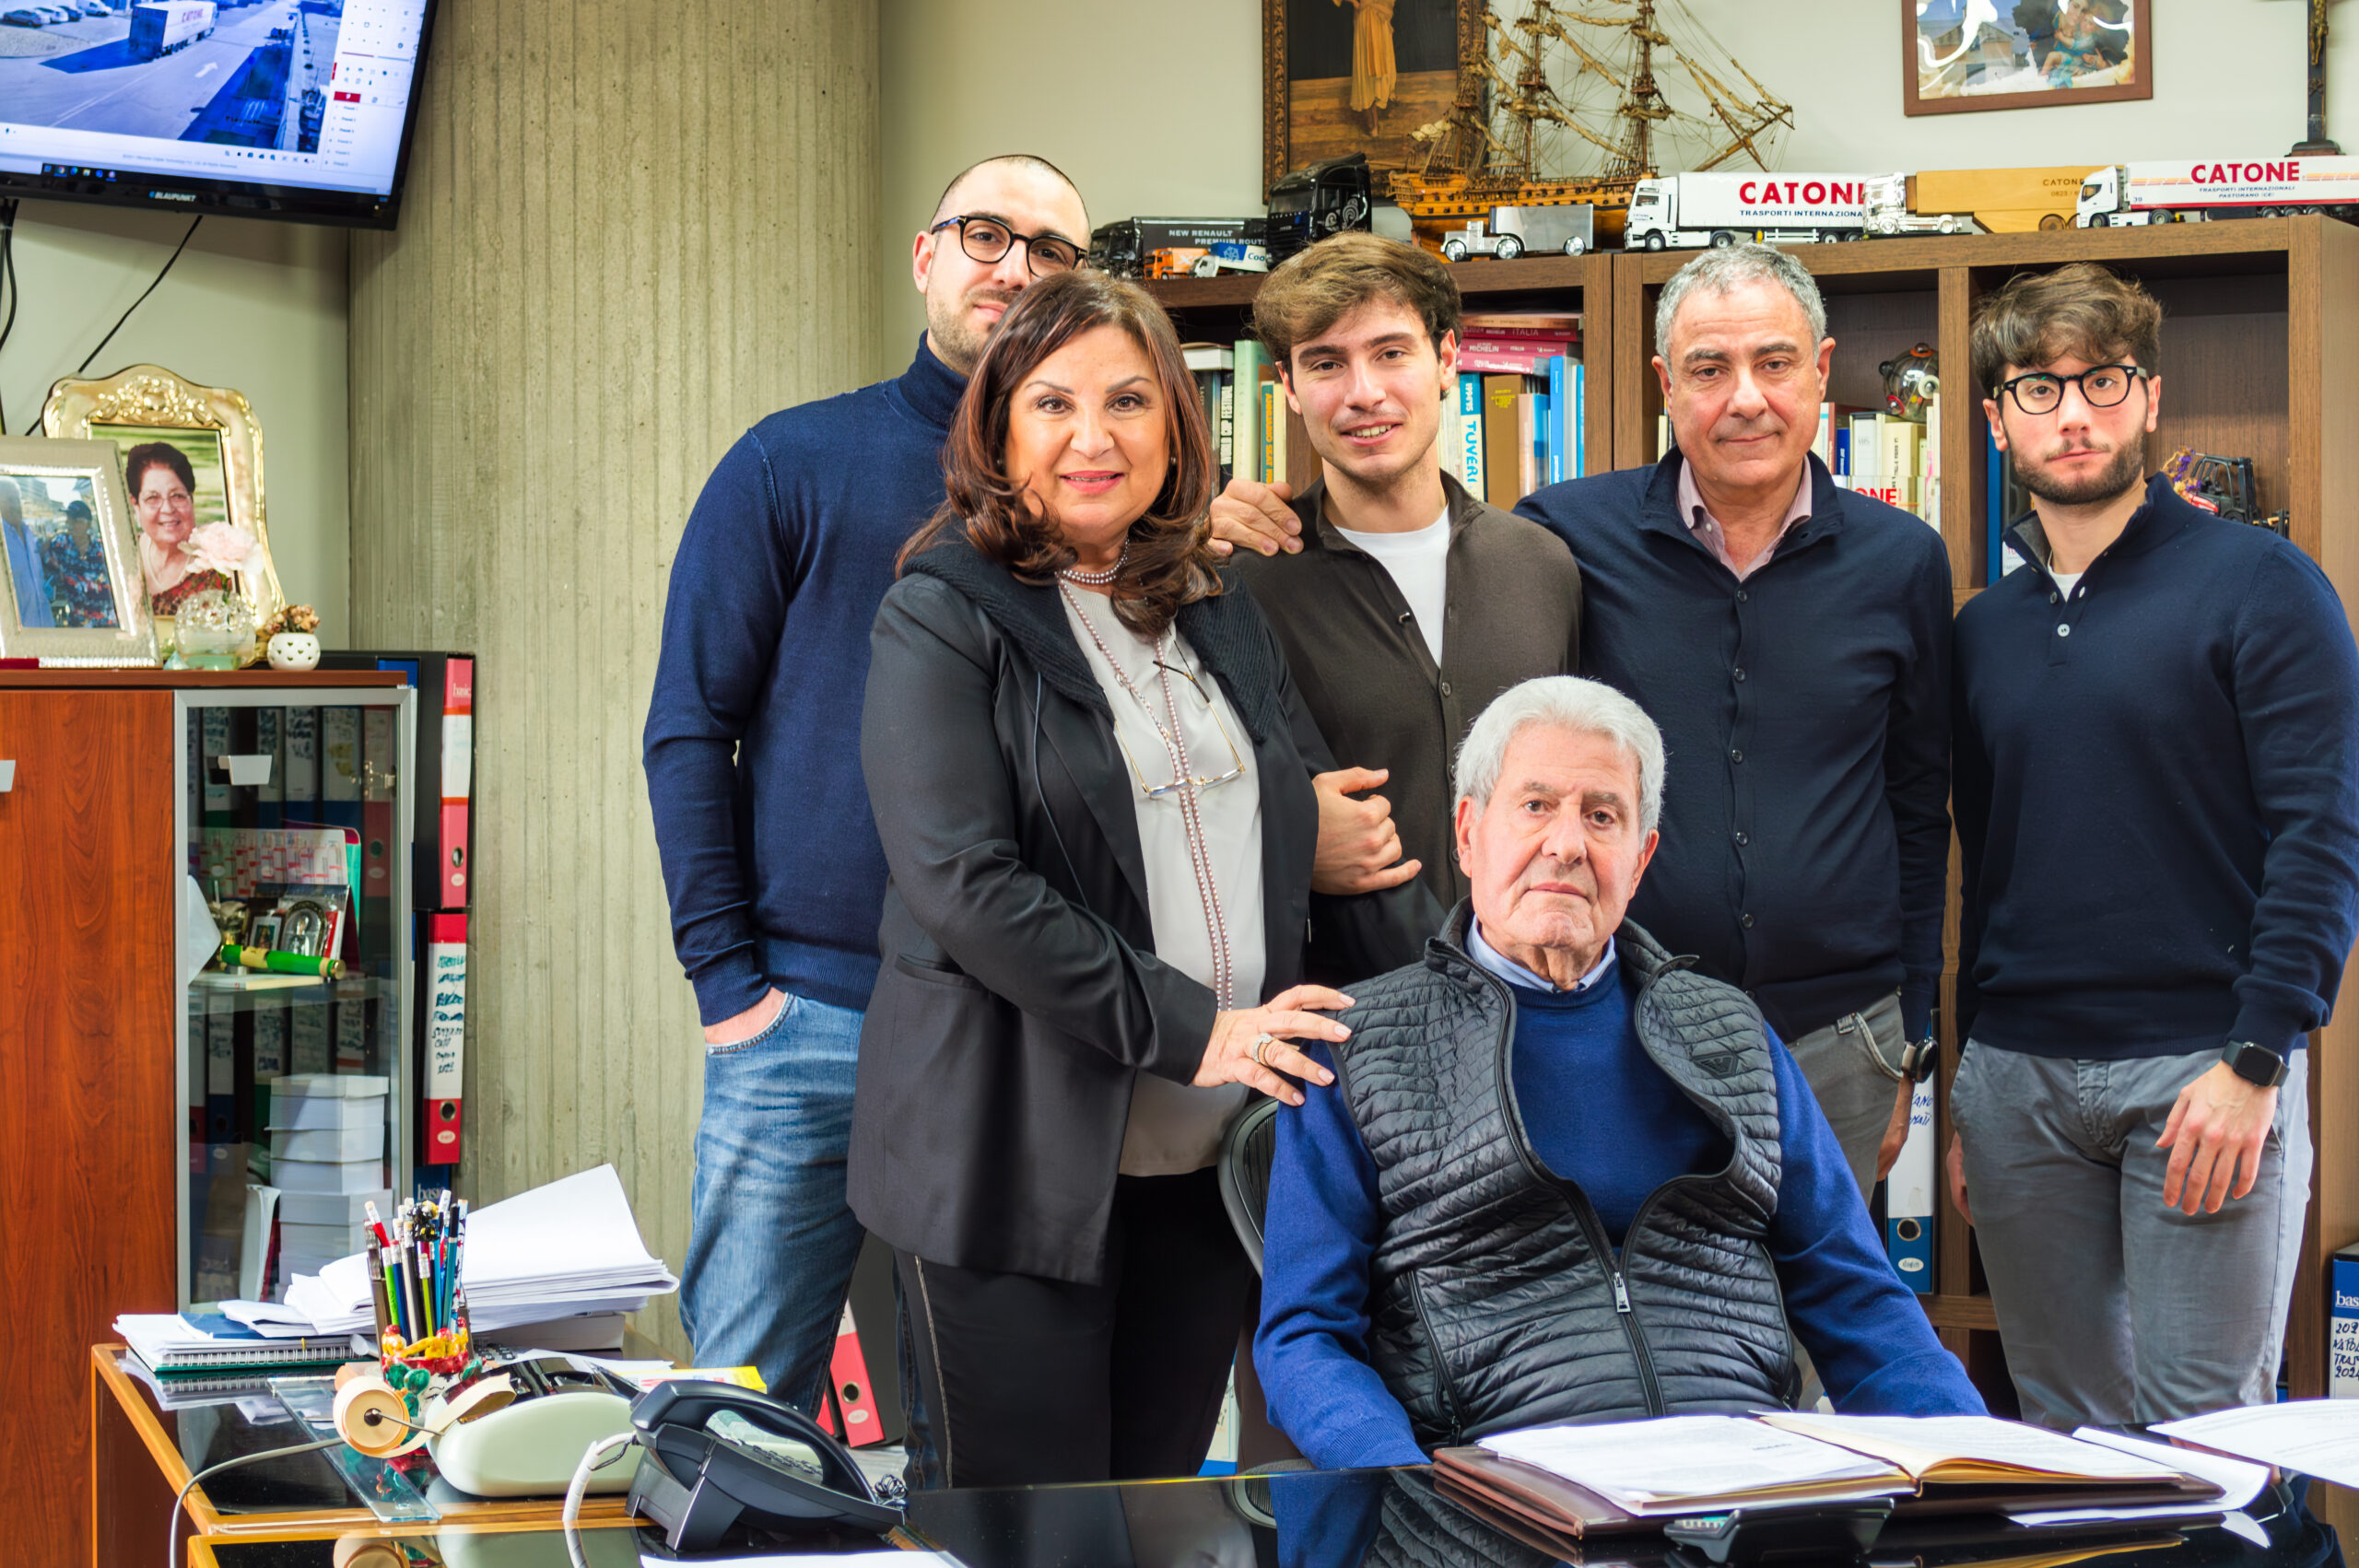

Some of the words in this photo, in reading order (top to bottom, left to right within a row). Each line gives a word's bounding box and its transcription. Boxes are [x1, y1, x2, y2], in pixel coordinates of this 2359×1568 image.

[2191, 161, 2300, 183] CATONE
[155, 191, 197, 202] BLAUPUNKT
[1794, 210, 1863, 218] INTERNAZIONA
[1248, 252, 1266, 262] Coo
[1512, 328, 1539, 336] ITALIA
[1469, 345, 1500, 353] MICHELIN
[1221, 385, 1233, 419] FESTIVAL
[1220, 419, 1233, 436] CUP
[1220, 437, 1233, 465] WORLD
[1465, 420, 1479, 483] TUVERI
[2336, 1290, 2359, 1306] bas
